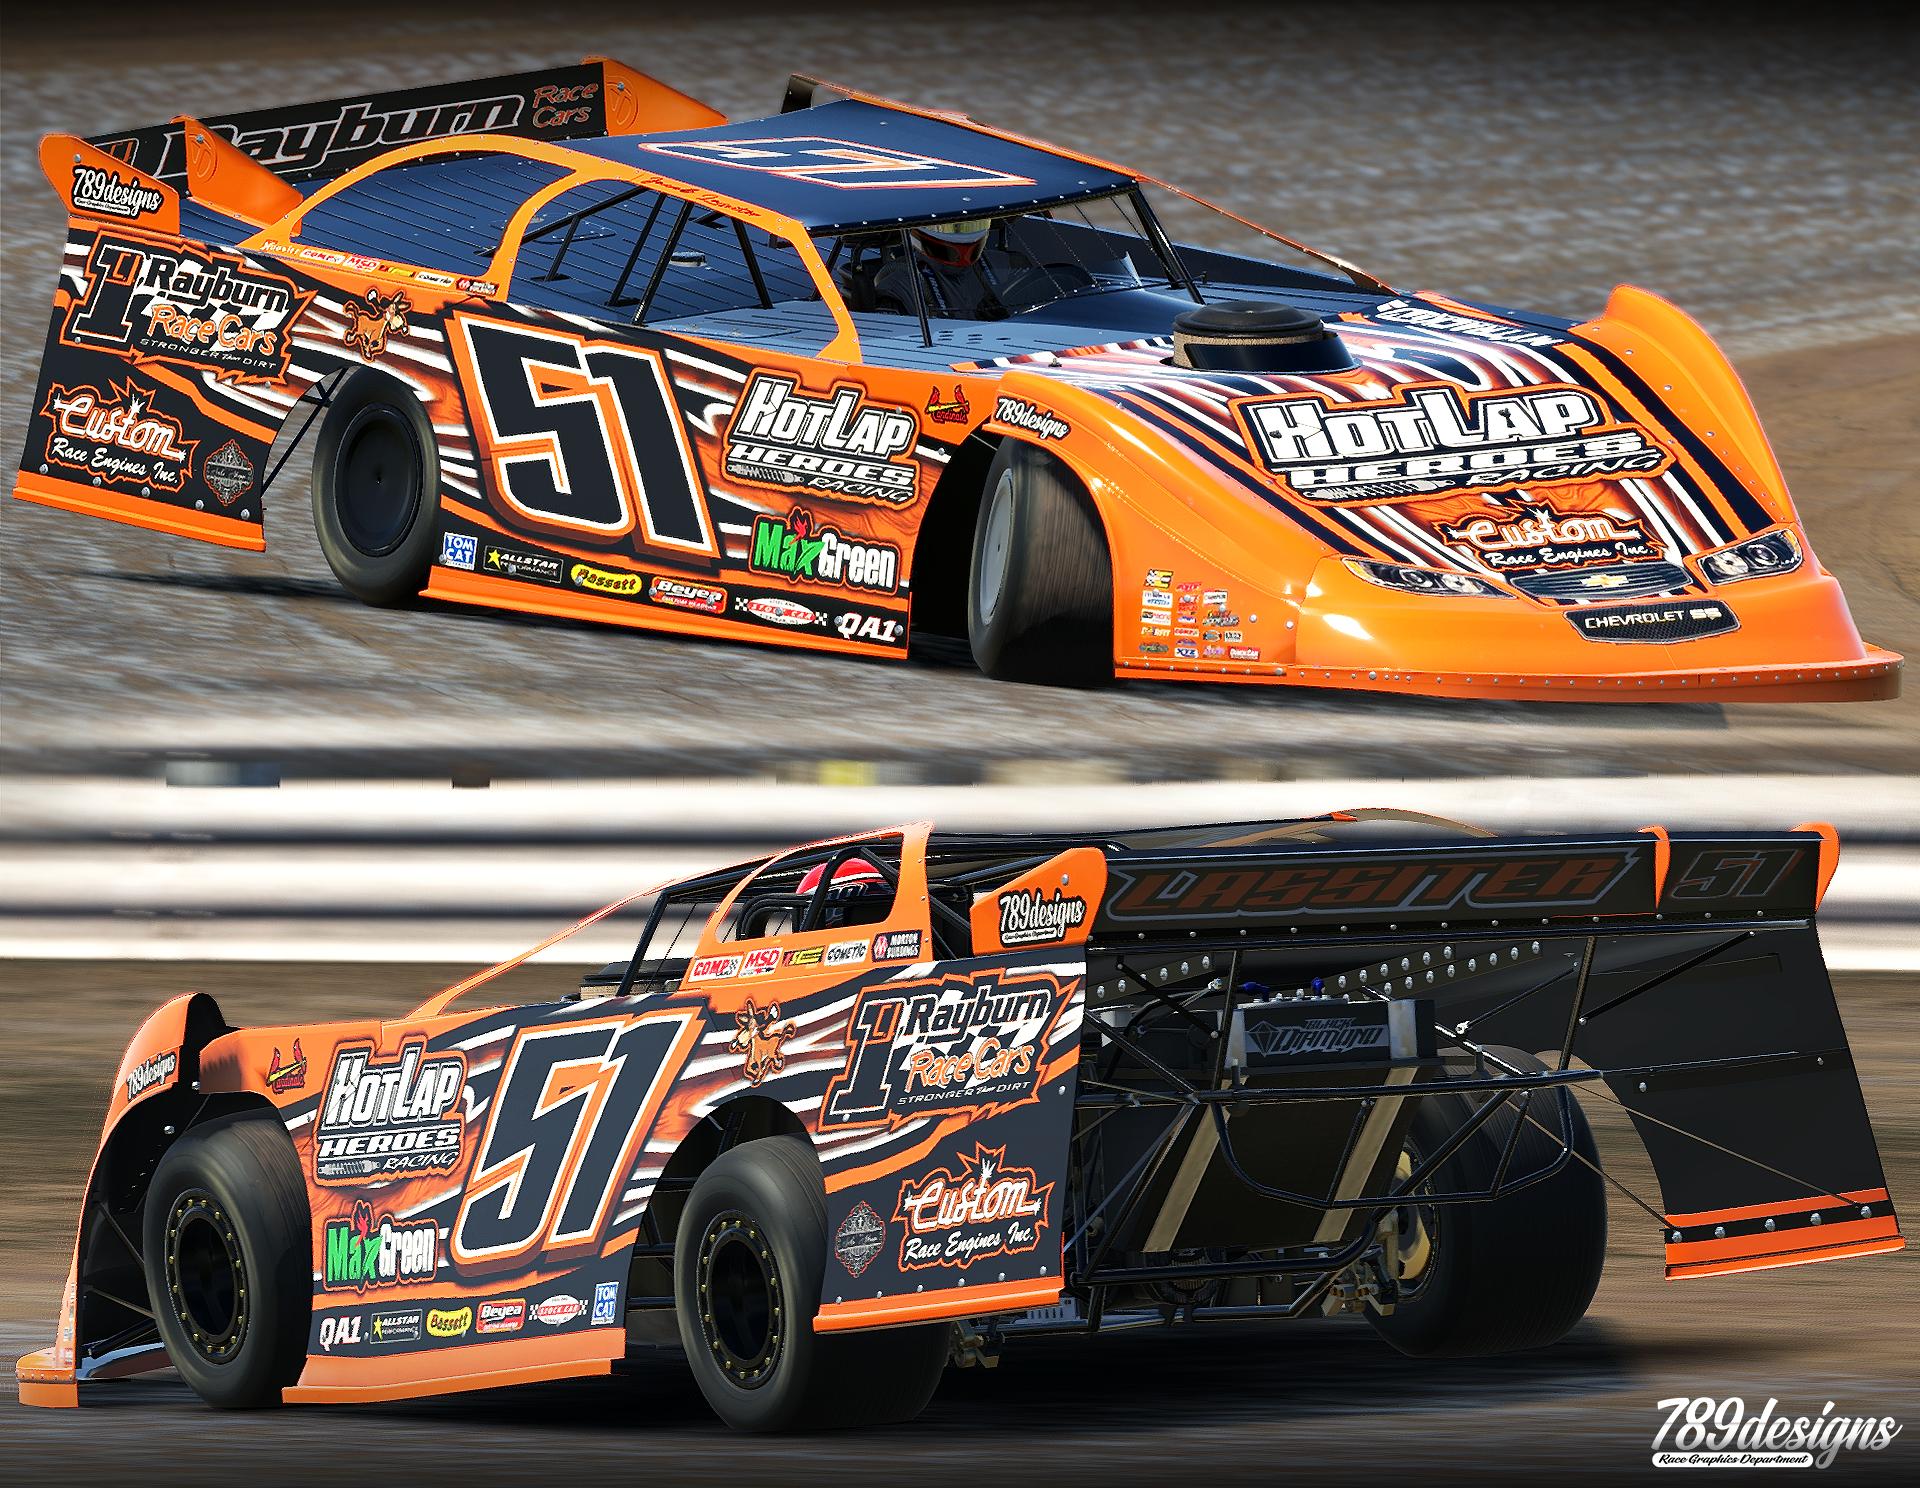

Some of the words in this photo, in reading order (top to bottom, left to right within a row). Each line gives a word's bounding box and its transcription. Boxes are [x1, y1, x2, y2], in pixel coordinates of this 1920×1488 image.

[533, 81, 599, 108] Race
[532, 105, 592, 129] Cars
[73, 168, 162, 217] 789designs
[144, 259, 288, 313] Rayburn
[148, 304, 217, 345] Race
[218, 314, 277, 355] Cars
[140, 338, 223, 360] STRONGER
[243, 357, 277, 370] DIRT
[53, 394, 187, 463] Custom
[458, 316, 713, 552] 51
[996, 397, 1071, 440] 789designs
[52, 437, 88, 463] Race
[91, 448, 148, 478] Engines
[153, 463, 178, 484] Inc.
[729, 443, 915, 487] HEROES
[1288, 434, 1644, 488] HEROES
[1465, 450, 1661, 487] RACING
[807, 475, 914, 502] RACING
[446, 535, 474, 550] TOM
[1447, 507, 1642, 548] Custom
[446, 548, 473, 564] CAT
[500, 553, 559, 569] ALLSTAR
[1484, 552, 1537, 566] Race
[1538, 547, 1612, 564] Engines
[1614, 542, 1653, 556] Inc.
[750, 603, 786, 615] STO
[1584, 610, 1685, 629] CHEVROLET
[1689, 607, 1722, 621] SS
[837, 611, 897, 643] QA1
[1121, 857, 1615, 911] LASSITER
[1671, 849, 1800, 900] 51
[1000, 892, 1085, 938] 789designs
[693, 959, 732, 977] COMP
[744, 949, 780, 969] MSD
[904, 984, 1051, 1045] Rayburn
[1303, 1017, 1357, 1030] BLACK
[1270, 1027, 1384, 1055] DIAMOND
[126, 1054, 176, 1100] 789designs
[904, 1049, 972, 1094] Race
[973, 1038, 1035, 1082] Cars
[896, 1088, 974, 1105] STRONGER
[996, 1082, 1031, 1093] DIRT
[318, 1126, 461, 1157] HEROES
[454, 1012, 694, 1259] 51
[382, 1150, 460, 1170] RACING
[903, 1157, 1042, 1231] Custom
[903, 1236, 943, 1262] Race
[944, 1230, 1002, 1259] Engines
[1006, 1221, 1035, 1245] Inc.
[595, 1300, 615, 1317] CAT
[597, 1286, 616, 1301] TOM
[381, 1315, 420, 1327] ALLSTAR
[481, 1304, 523, 1320] Beyea
[319, 1315, 362, 1352] QA1
